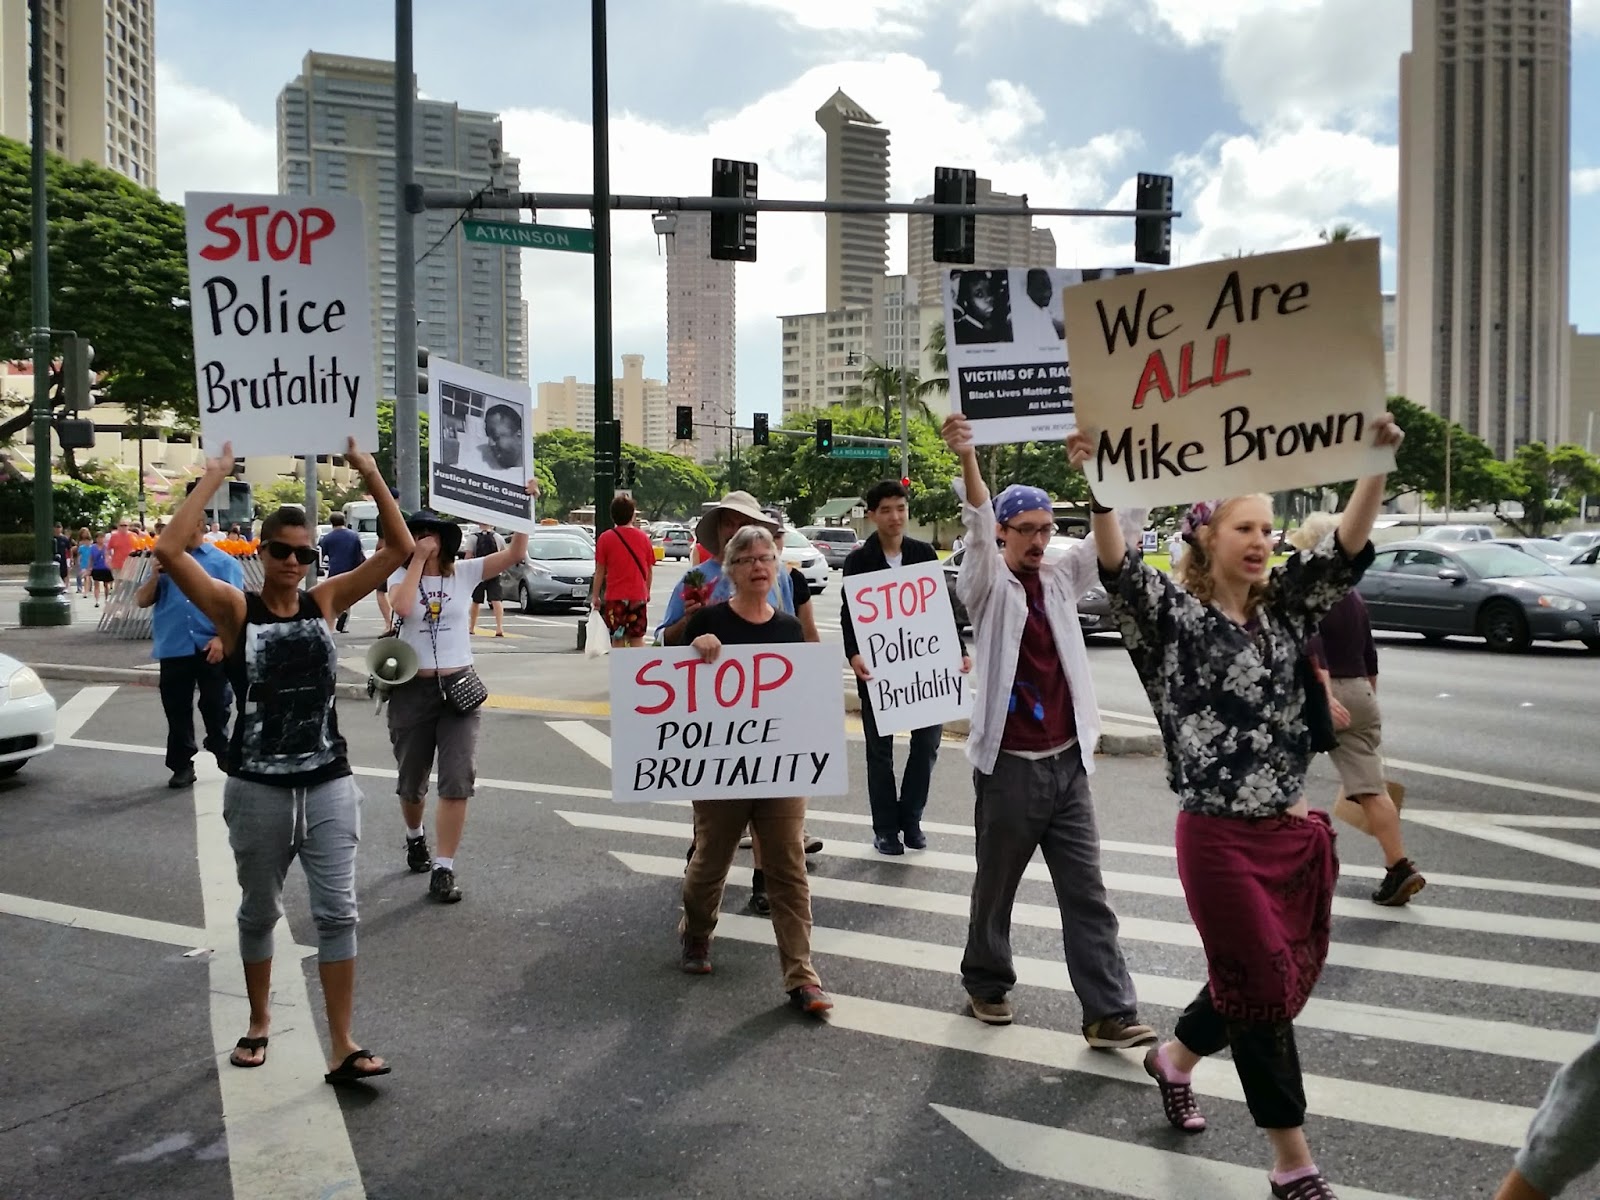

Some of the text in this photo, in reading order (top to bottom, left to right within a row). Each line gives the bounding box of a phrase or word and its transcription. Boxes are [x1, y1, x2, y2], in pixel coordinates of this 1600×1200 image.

[199, 203, 335, 266] STOP
[475, 225, 570, 247] ATKINSON
[202, 275, 346, 337] Police
[1096, 270, 1311, 355] We Are
[202, 355, 360, 418] Brutality
[963, 369, 1016, 383] VICTIMS
[1018, 368, 1035, 380] OF
[1037, 367, 1047, 379] A
[968, 390, 995, 400] Black
[996, 388, 1020, 398] Lives
[1022, 387, 1053, 397] Matter
[1133, 334, 1252, 410] ALL
[1096, 406, 1364, 483] Mike Brown
[434, 470, 531, 501] Justice for Eric Garner
[856, 576, 937, 624] STOP
[868, 626, 939, 668] Police
[634, 653, 793, 715] STOP
[876, 667, 963, 711] Brutality
[657, 719, 782, 750] POLICE
[634, 752, 830, 791] BRUTALITY
